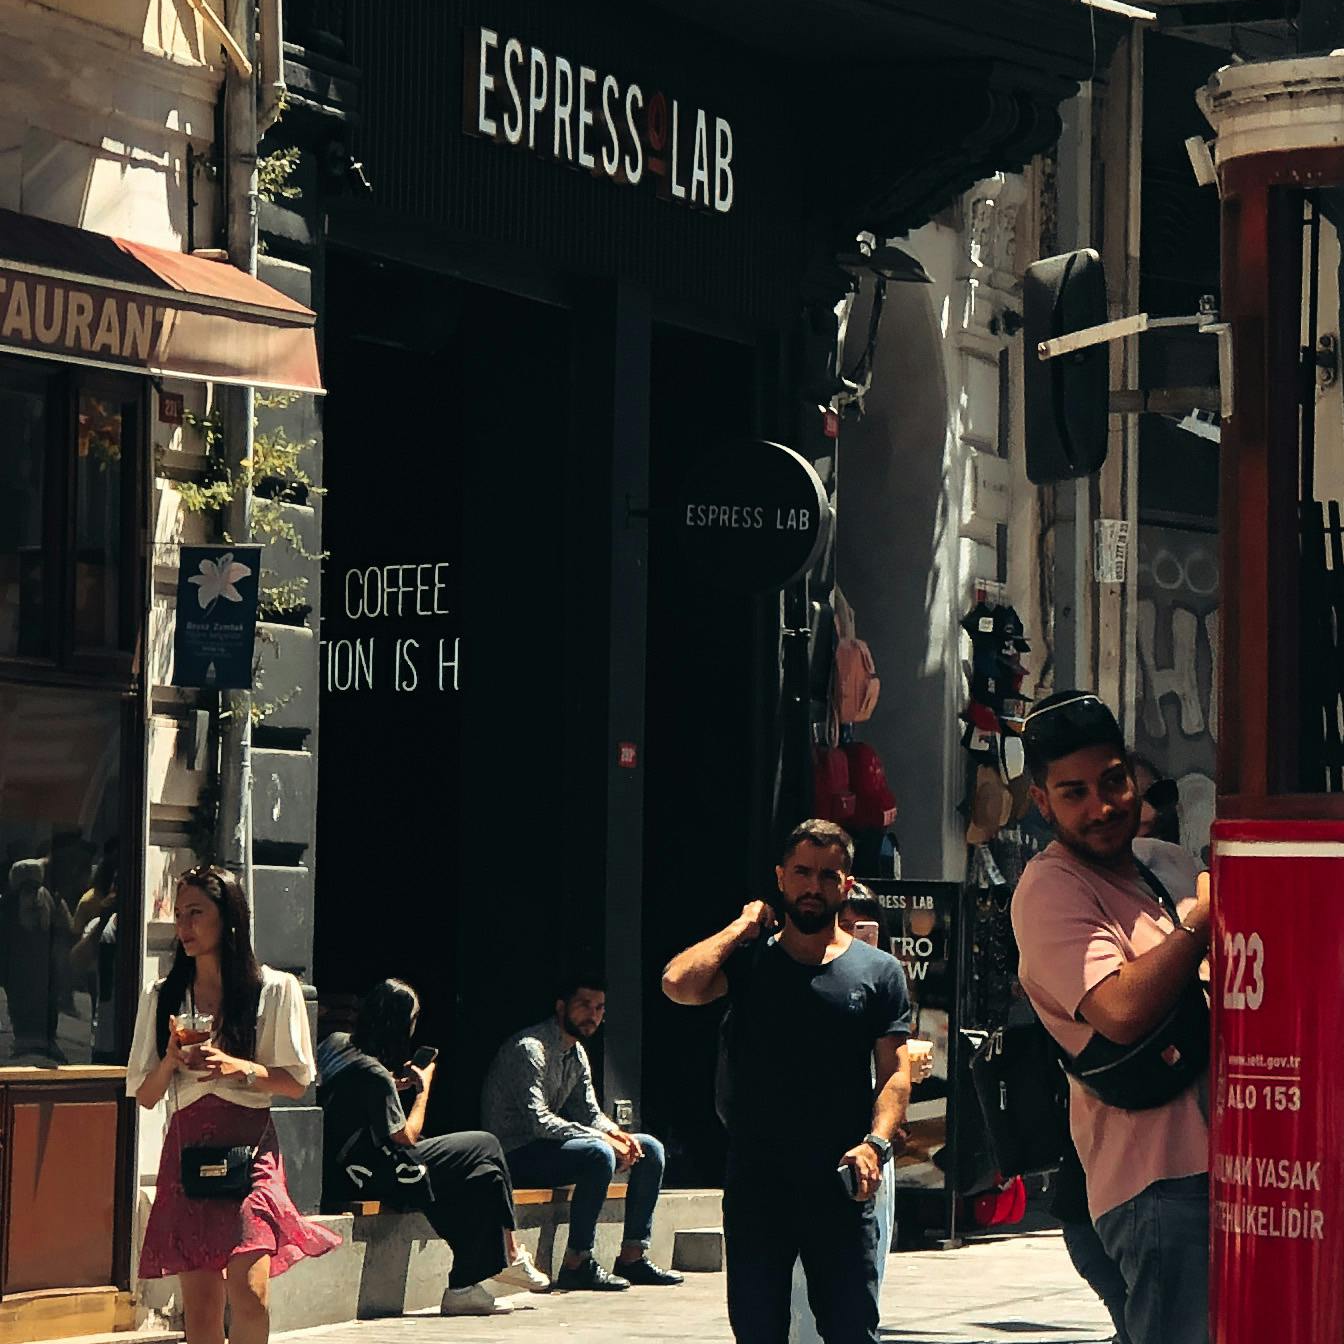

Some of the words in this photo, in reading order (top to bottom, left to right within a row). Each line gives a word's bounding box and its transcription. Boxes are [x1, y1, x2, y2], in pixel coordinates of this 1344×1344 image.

[671, 98, 735, 214] LAB
[776, 508, 809, 531] LAB
[345, 562, 450, 619] COFFEE
[319, 637, 375, 692] ION
[395, 638, 420, 692] IS
[438, 637, 460, 692] H
[912, 895, 935, 910] LAB
[889, 937, 933, 957] TRO
[1223, 931, 1265, 1010] 223
[1227, 1084, 1257, 1110] ALO
[1263, 1085, 1301, 1112] 153
[1255, 1156, 1321, 1192] YASAK
